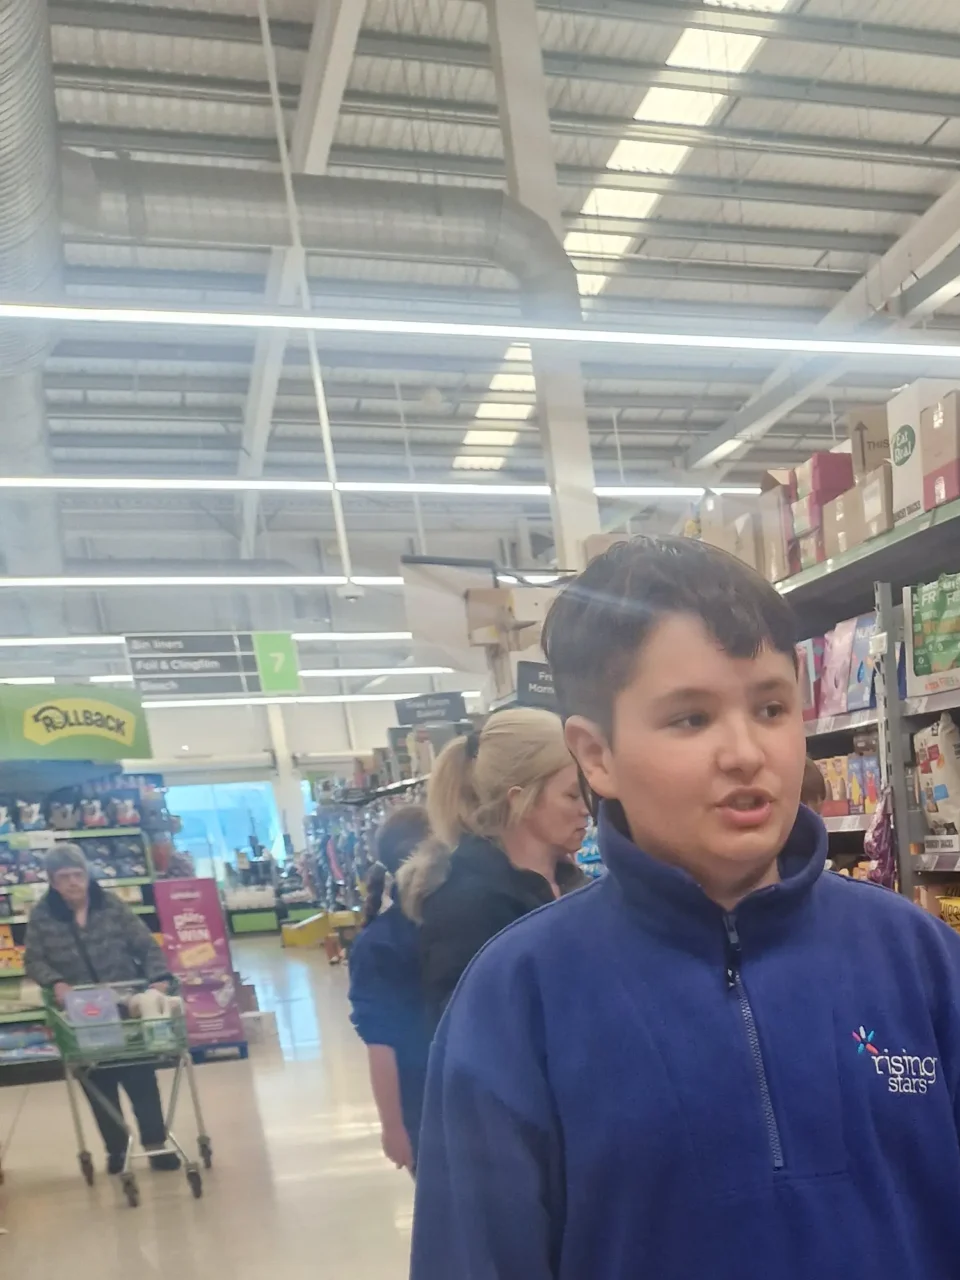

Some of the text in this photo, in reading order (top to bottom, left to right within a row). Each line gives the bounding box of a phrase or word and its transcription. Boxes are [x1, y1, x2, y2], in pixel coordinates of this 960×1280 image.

[269, 653, 286, 673] 7
[870, 1048, 938, 1084] rising
[888, 1074, 928, 1094] stars
